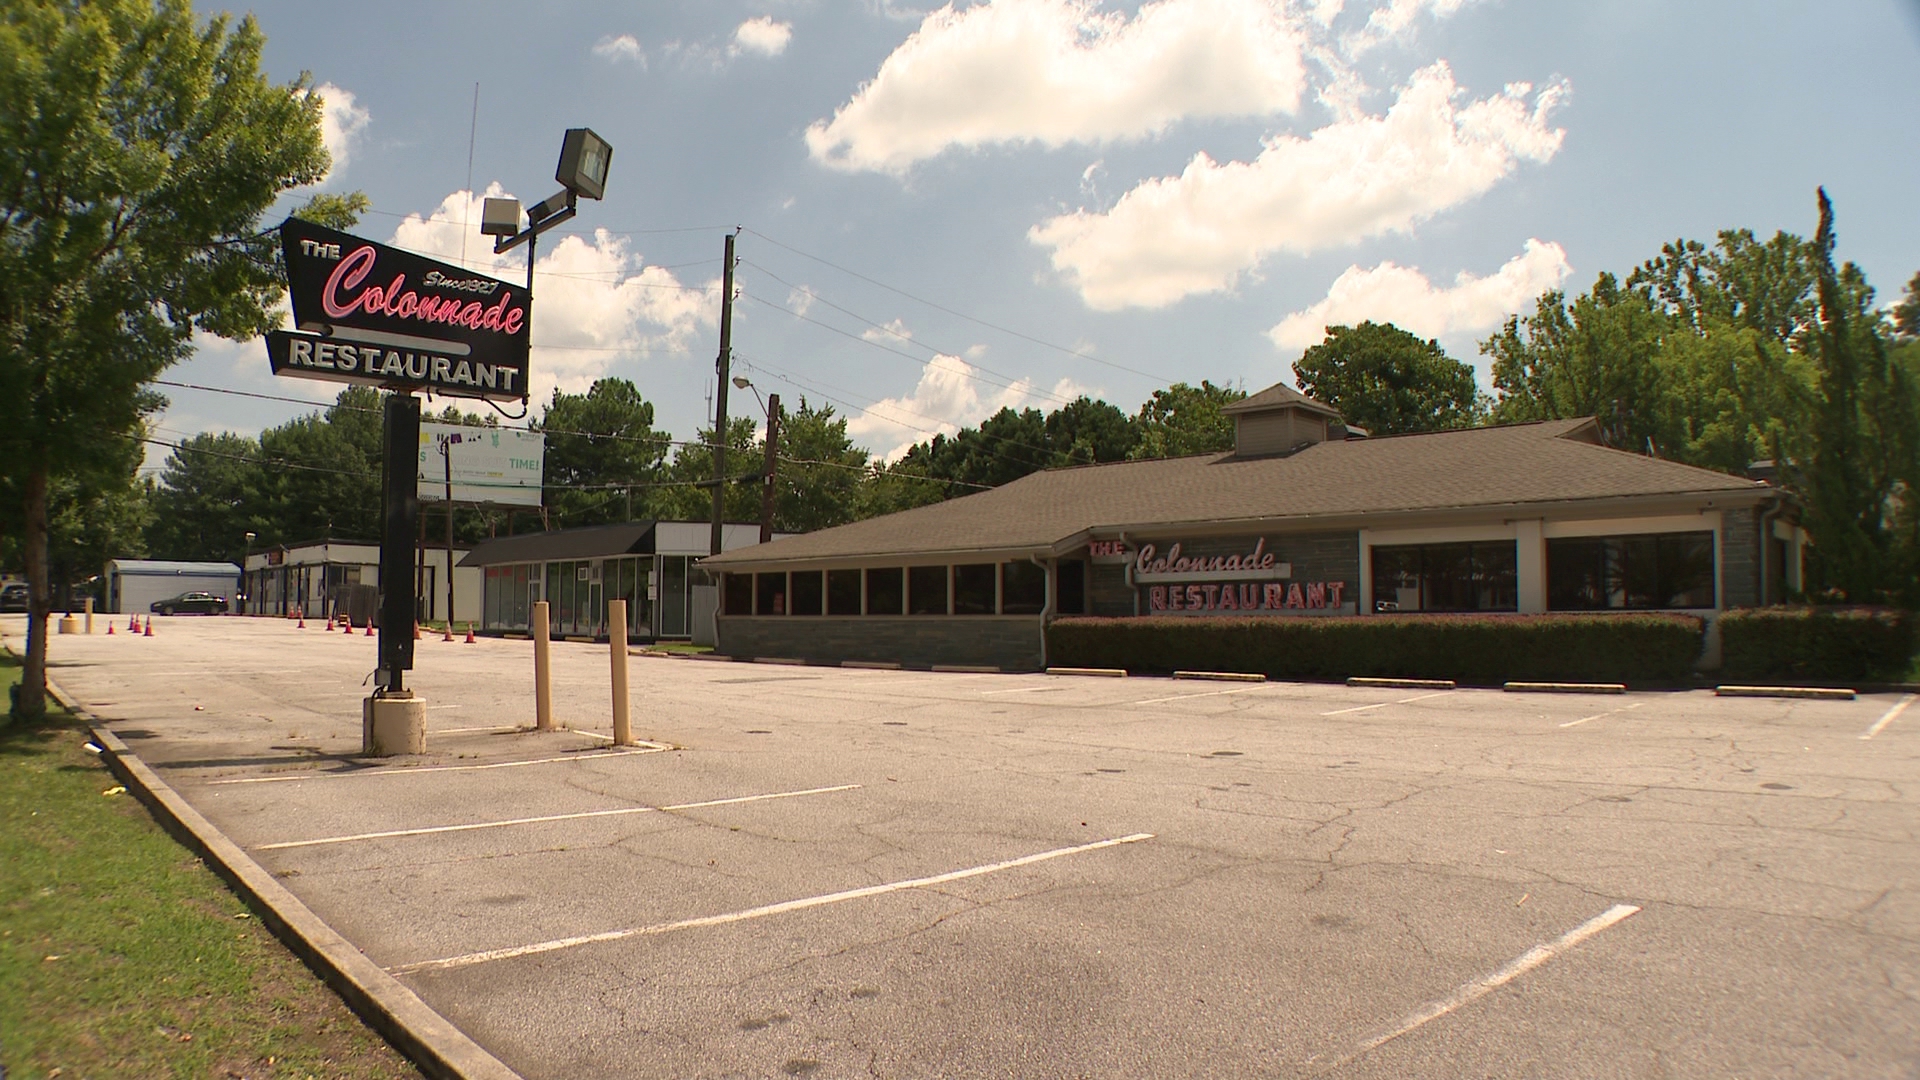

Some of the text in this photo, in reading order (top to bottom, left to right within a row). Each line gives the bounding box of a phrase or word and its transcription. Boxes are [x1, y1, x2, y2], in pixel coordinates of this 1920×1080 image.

[300, 240, 341, 259] THE
[323, 245, 524, 335] Colonnade
[289, 338, 519, 391] RESTAURANT
[509, 458, 540, 471] TIME!
[1089, 540, 1124, 557] THE
[1136, 537, 1275, 573] Colonnade
[1150, 582, 1345, 611] RESTAURANT
